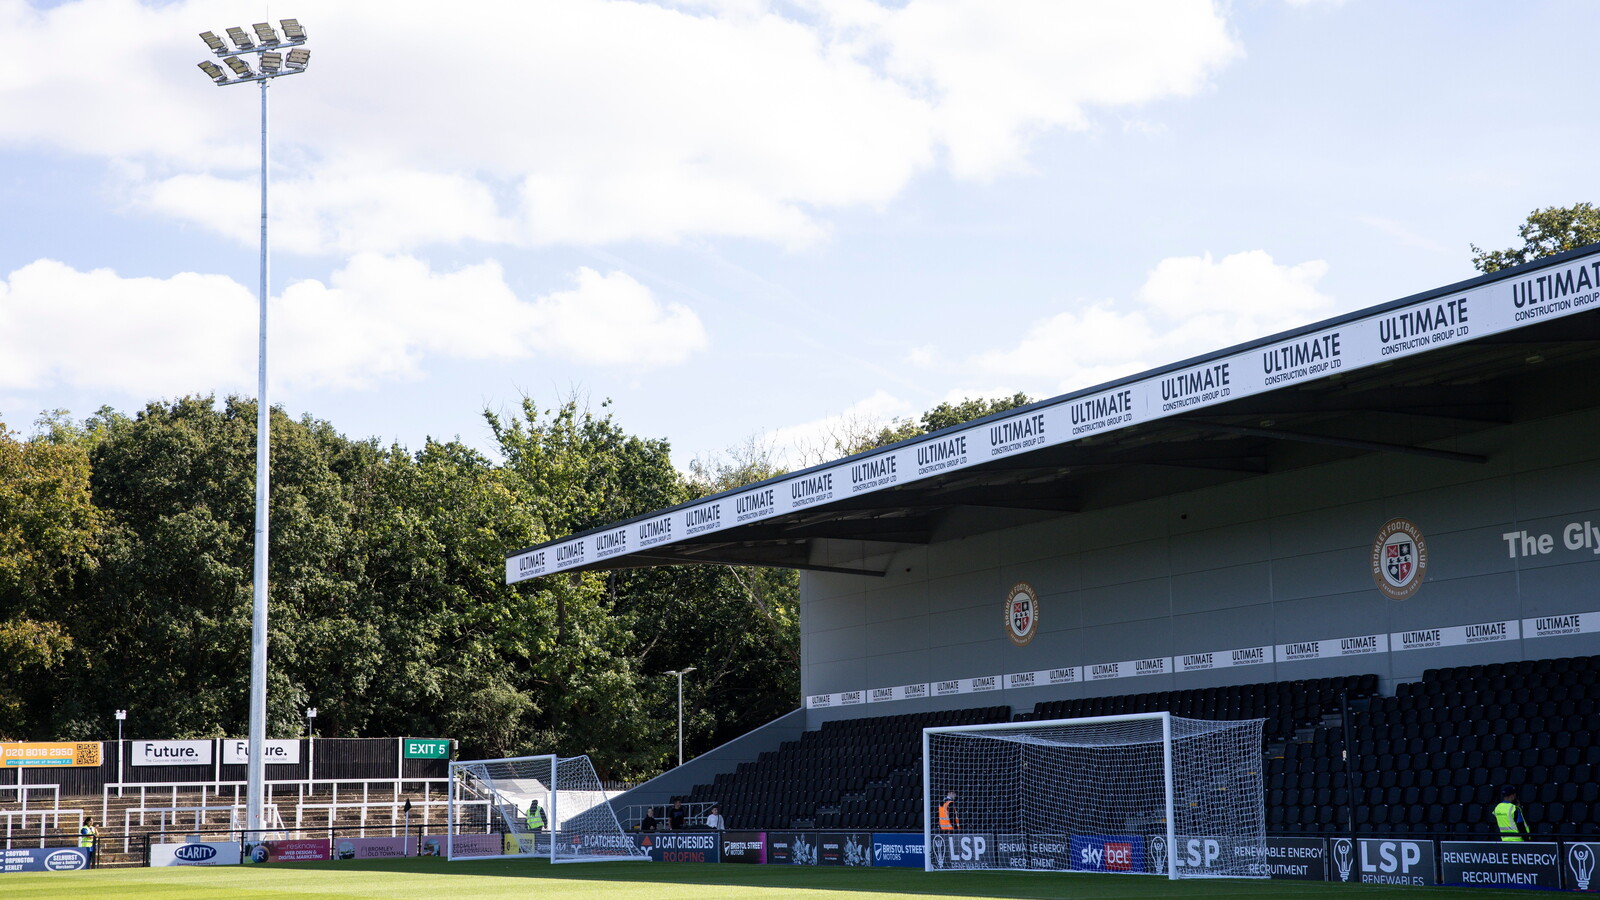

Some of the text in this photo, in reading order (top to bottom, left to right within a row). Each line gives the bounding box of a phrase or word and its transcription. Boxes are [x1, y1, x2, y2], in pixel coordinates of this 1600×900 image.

[1516, 292, 1599, 321] CONSTRUCTION GROUP
[1380, 297, 1468, 344] ULTIMATE
[1382, 326, 1469, 356] CONSTRUCTION GROUP LTD
[1264, 333, 1340, 375] ULTIMATE
[1265, 359, 1341, 386] CONSTRUCTION GROUP LTD
[1162, 362, 1229, 402] ULTIMATE
[1163, 388, 1230, 412] CONSTRUCTION GROUP LTD
[1072, 390, 1131, 425] ULTIMATE
[990, 414, 1044, 447] ULTIMATE
[1072, 413, 1132, 435] CONSTRUCTION GROUP LTD
[918, 435, 966, 466] ULTIMATE
[991, 442, 1021, 456] CONSTRUCTION
[1022, 438, 1036, 448] GROUP
[852, 455, 896, 483] ULTIMATE
[918, 462, 945, 475] CONSTRUCTION
[946, 458, 958, 468] GROUP
[792, 472, 832, 499] ULTIMATE
[853, 479, 877, 492] CONSTRUCTION
[878, 476, 889, 485] GROUP
[737, 489, 774, 514] ULTIMATE
[793, 496, 815, 507] CONSTRUCTION
[816, 493, 826, 501] GROUP
[686, 504, 720, 527] ULTIMATE
[738, 510, 758, 522] CONSTRUCTION
[759, 508, 768, 516] GROUP
[640, 517, 670, 539] ULTIMATE
[687, 524, 706, 534] CONSTRUCTION
[706, 522, 715, 530] GROUP
[597, 530, 626, 551] ULTIMATE
[1374, 530, 1387, 573] BROMLEY
[1387, 522, 1420, 541] FOOTBALL
[1503, 530, 1553, 558] The
[557, 541, 584, 561] ULTIMATE
[520, 552, 545, 571] ULTIMATE
[1536, 616, 1579, 630] ULTIMATE
[1402, 630, 1440, 644] ULTIMATE
[1465, 623, 1505, 638] ULTIMATE
[1285, 642, 1318, 656] ULTIMATE
[1341, 636, 1376, 650] ULTIMATE
[1183, 654, 1212, 665] ULTIMATE
[1232, 648, 1263, 660] ULTIMATE
[1092, 664, 1118, 674] ULTIMATE
[1135, 660, 1163, 670] ULTIMATE
[1010, 673, 1034, 683] ULTIMATE
[1050, 668, 1074, 679] ULTIMATE
[937, 681, 958, 690] ULTIMATE
[972, 677, 994, 687] ULTIMATE
[842, 692, 860, 701] ULTIMATE
[873, 689, 892, 697] ULTIMATE
[905, 685, 924, 694] ULTIMATE
[812, 695, 830, 703] ULTIMATE
[145, 744, 198, 757] Future.
[237, 742, 287, 756] Fre.
[410, 744, 445, 754] EXIT 5
[584, 835, 634, 848] D CATCHESIDES
[656, 836, 713, 848] D CATCHESIDES
[949, 836, 985, 860] LSP
[1000, 843, 1065, 853] RENEWALE ENERGY
[176, 846, 214, 858] CLARITY
[257, 851, 264, 859] R
[883, 845, 925, 854] BRISTOL STREET
[1082, 844, 1129, 868] sky bet
[1175, 839, 1220, 867] LSP
[1234, 847, 1323, 859] RENEWABLE ENERGY
[663, 852, 704, 862] ROOFING
[1010, 858, 1054, 867] RECRITMENT
[1361, 842, 1420, 874] LSP
[1443, 852, 1556, 865] RENEWABLE ENERGY
[1250, 864, 1308, 875] RECRUITMENT
[1362, 875, 1424, 886] RENEWABLES
[1462, 872, 1538, 884] RECRUITMENT
